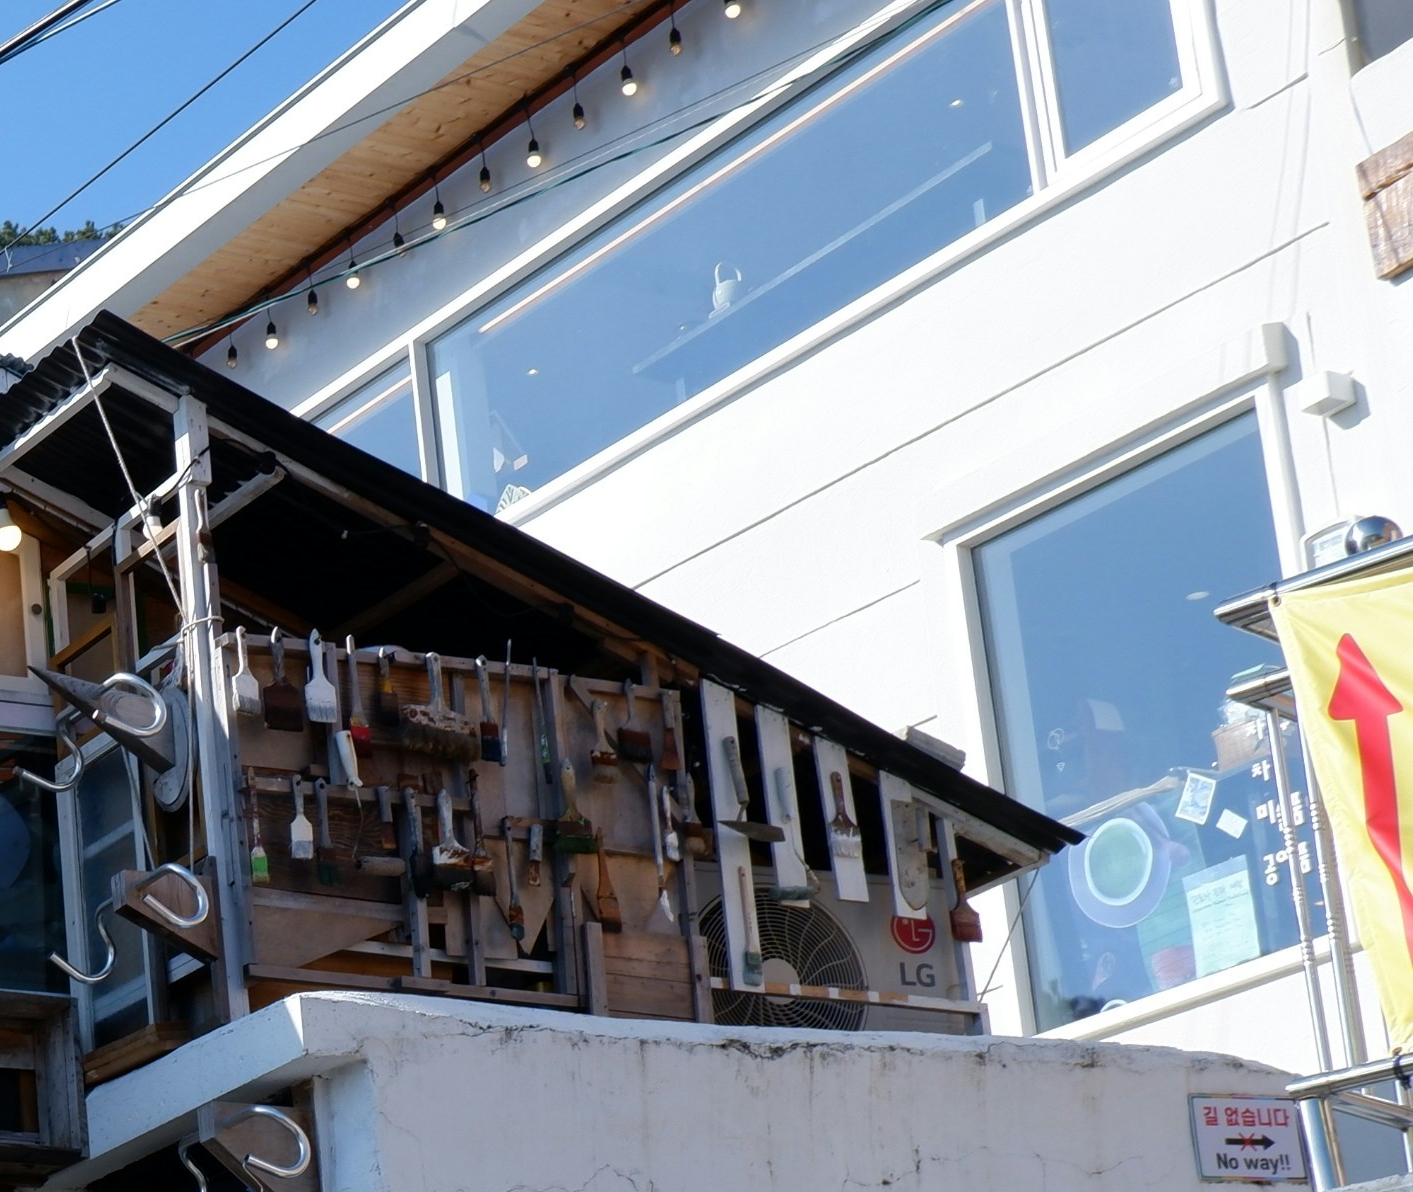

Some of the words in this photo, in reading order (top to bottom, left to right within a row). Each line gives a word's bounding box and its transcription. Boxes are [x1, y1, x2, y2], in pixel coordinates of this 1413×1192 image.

[899, 962, 935, 987] LG
[1203, 1107, 1219, 1127] 길
[1225, 1107, 1290, 1127] 없습니다
[1216, 1153, 1239, 1169] No
[1243, 1154, 1291, 1175] way!!
